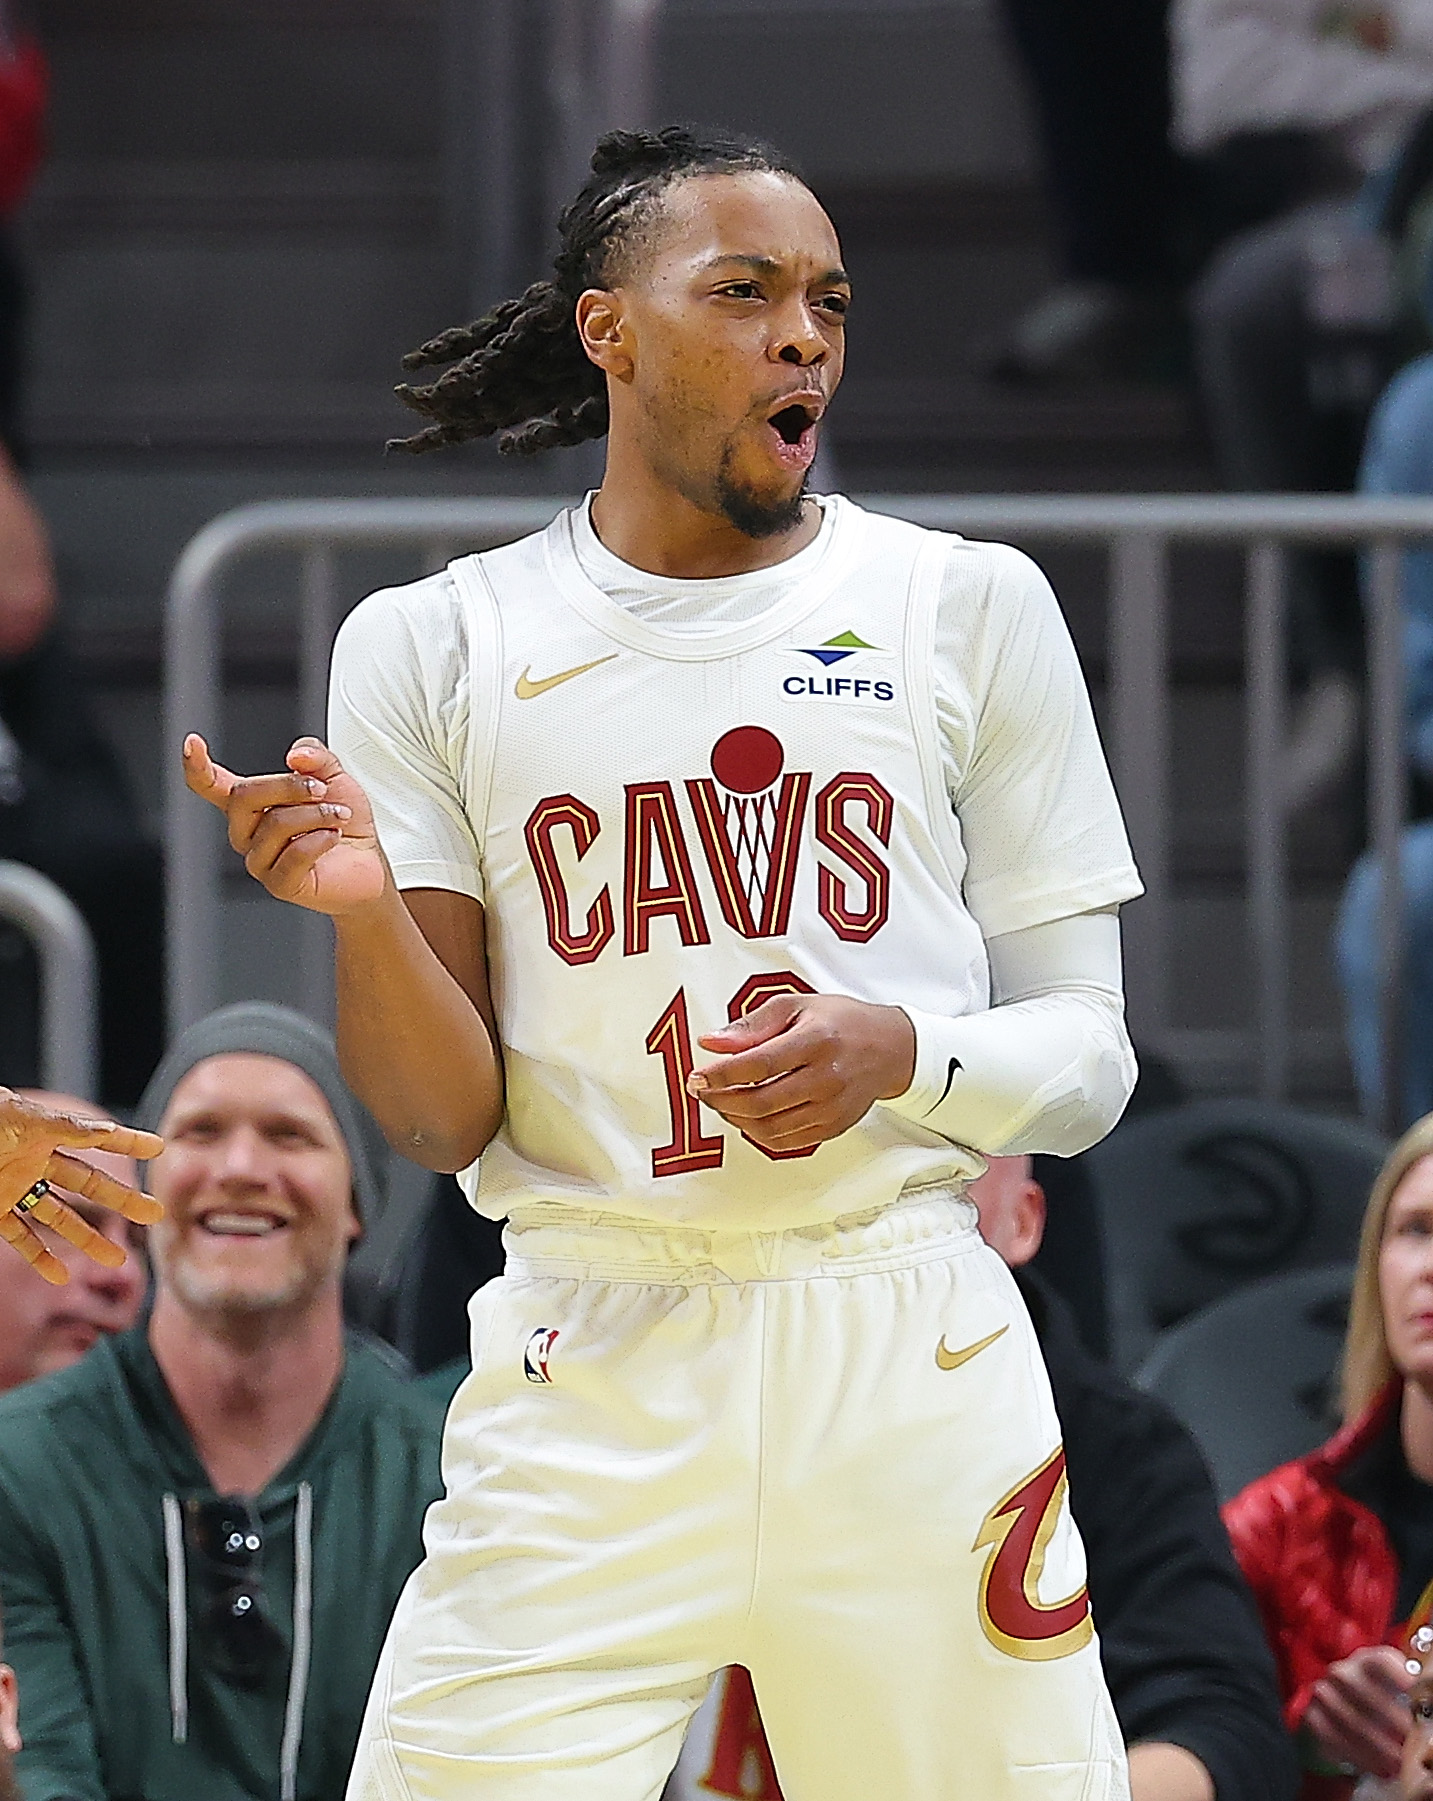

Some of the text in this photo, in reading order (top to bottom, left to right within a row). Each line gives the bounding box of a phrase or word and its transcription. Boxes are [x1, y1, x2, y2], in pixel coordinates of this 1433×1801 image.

[782, 676, 894, 701] CLIFFS
[523, 771, 895, 967] CAVS
[645, 970, 824, 1178] 1
